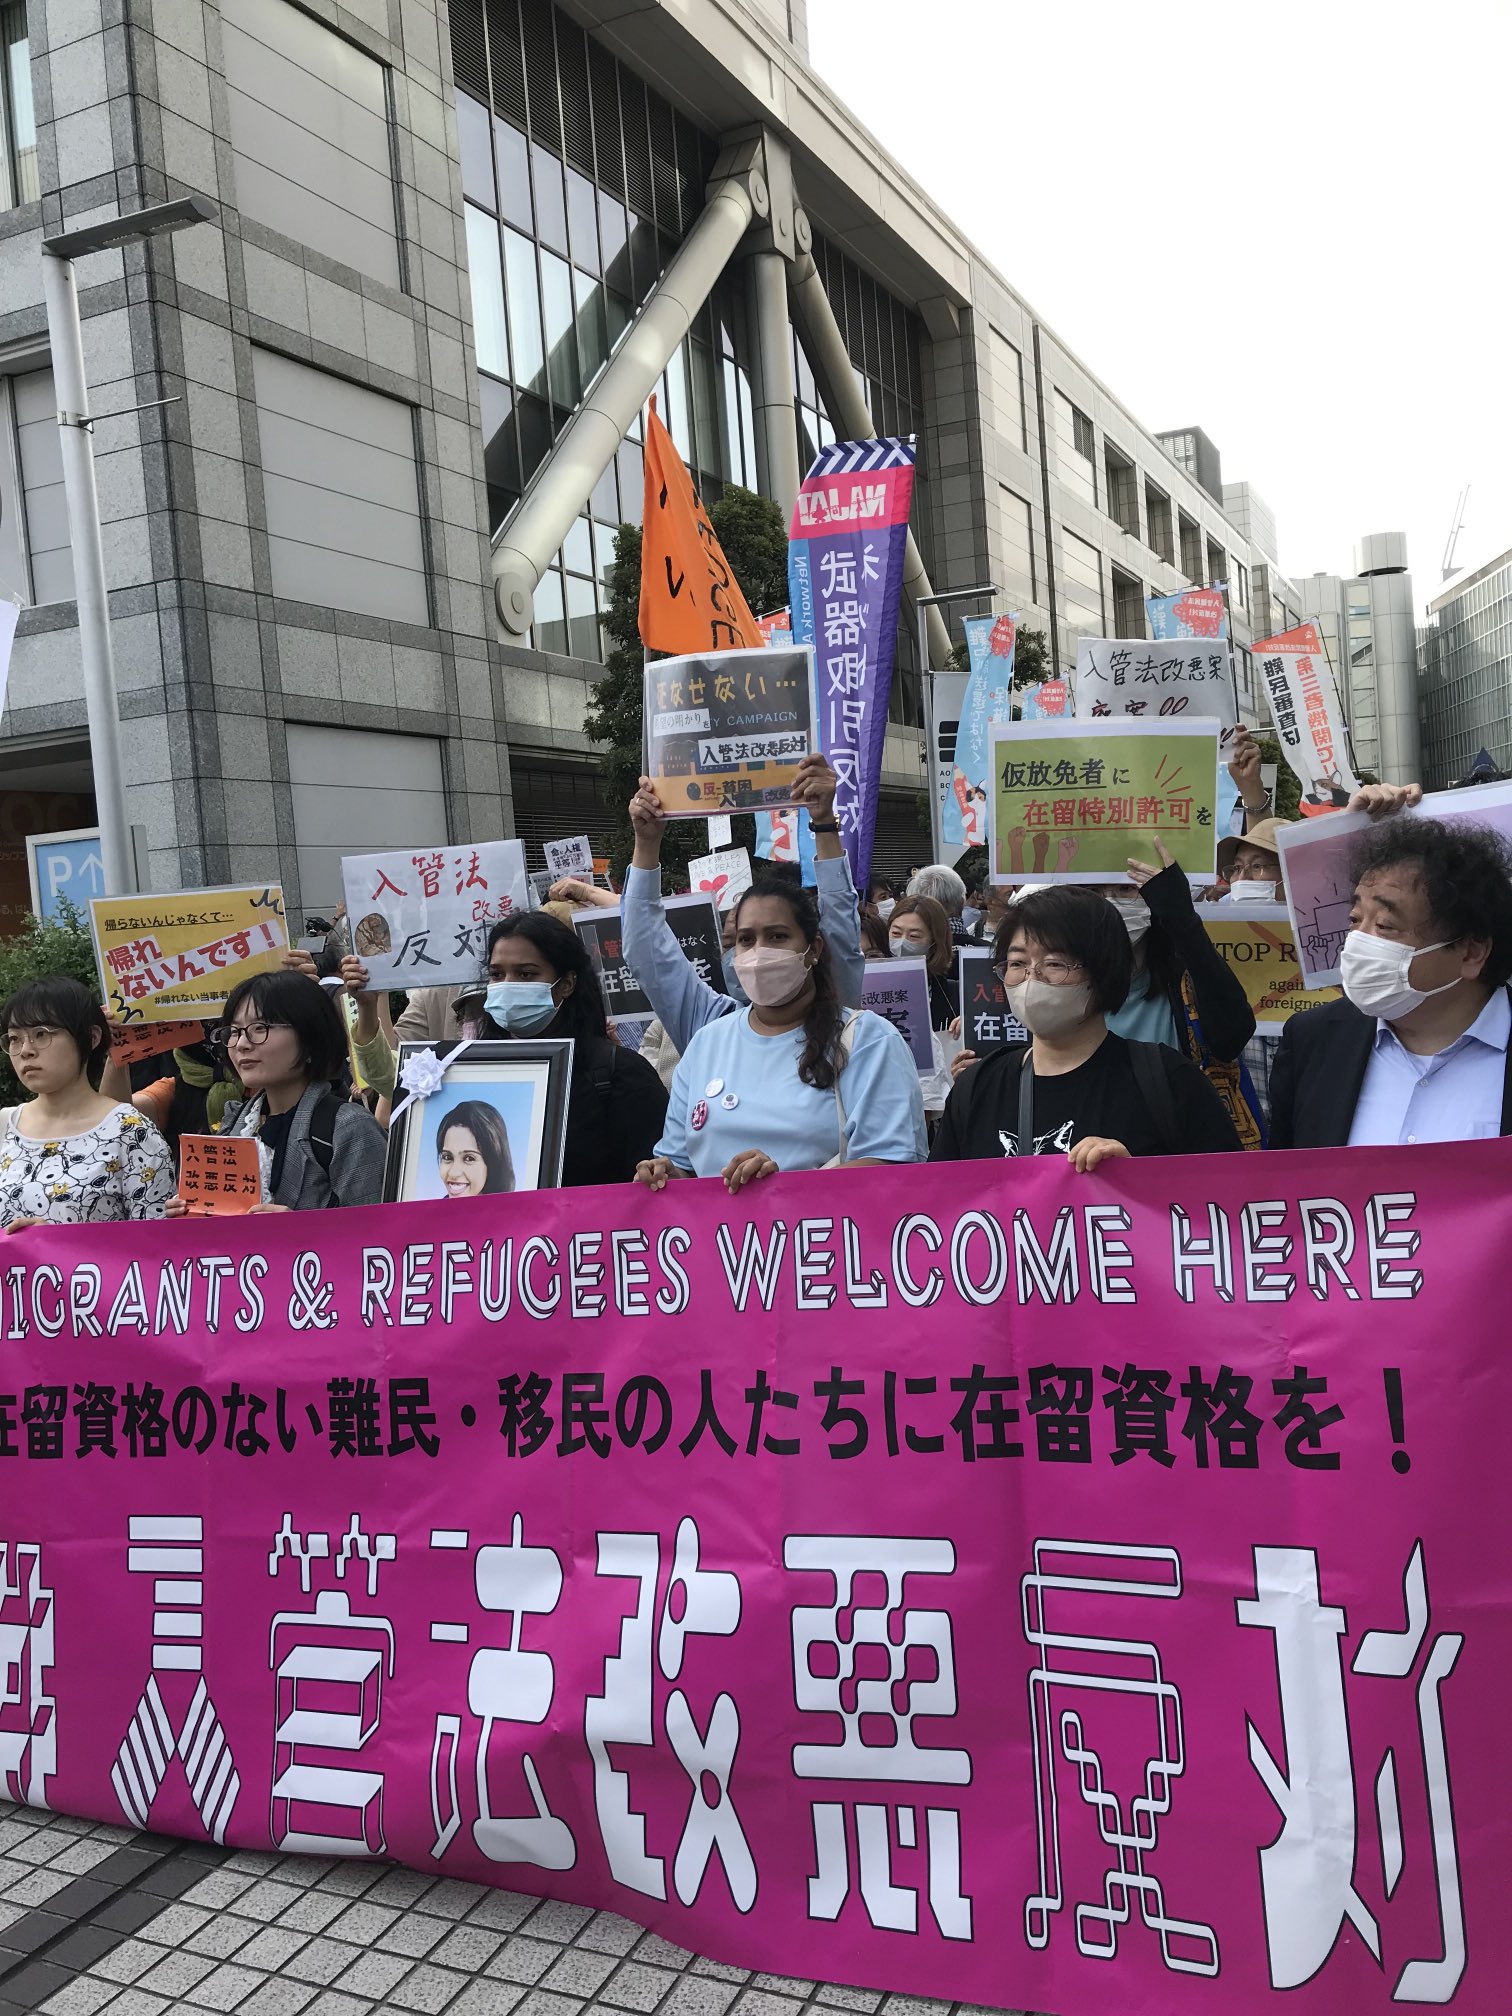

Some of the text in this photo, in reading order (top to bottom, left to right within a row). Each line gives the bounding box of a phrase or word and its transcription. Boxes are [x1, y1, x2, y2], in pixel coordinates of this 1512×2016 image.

[1083, 649, 1226, 686] 入管法改悪案
[727, 711, 798, 727] CAMPAIGN
[702, 735, 807, 765] 入管法改悪反対
[1001, 758, 1131, 788] 仮放免者に
[1022, 795, 1212, 827] 在留特別許可を
[47, 855, 73, 898] P
[371, 851, 489, 901] 入管法
[105, 911, 234, 931] 帰らないんじゃなくて…
[106, 939, 162, 975] 帰れ
[391, 919, 494, 968] 反対
[1212, 942, 1271, 963] TOP
[117, 922, 277, 1000] ないんです！
[973, 1011, 1029, 1042] 在留
[0, 1190, 1424, 1340] IGRANTS & REFUGEES WELCOME HERE
